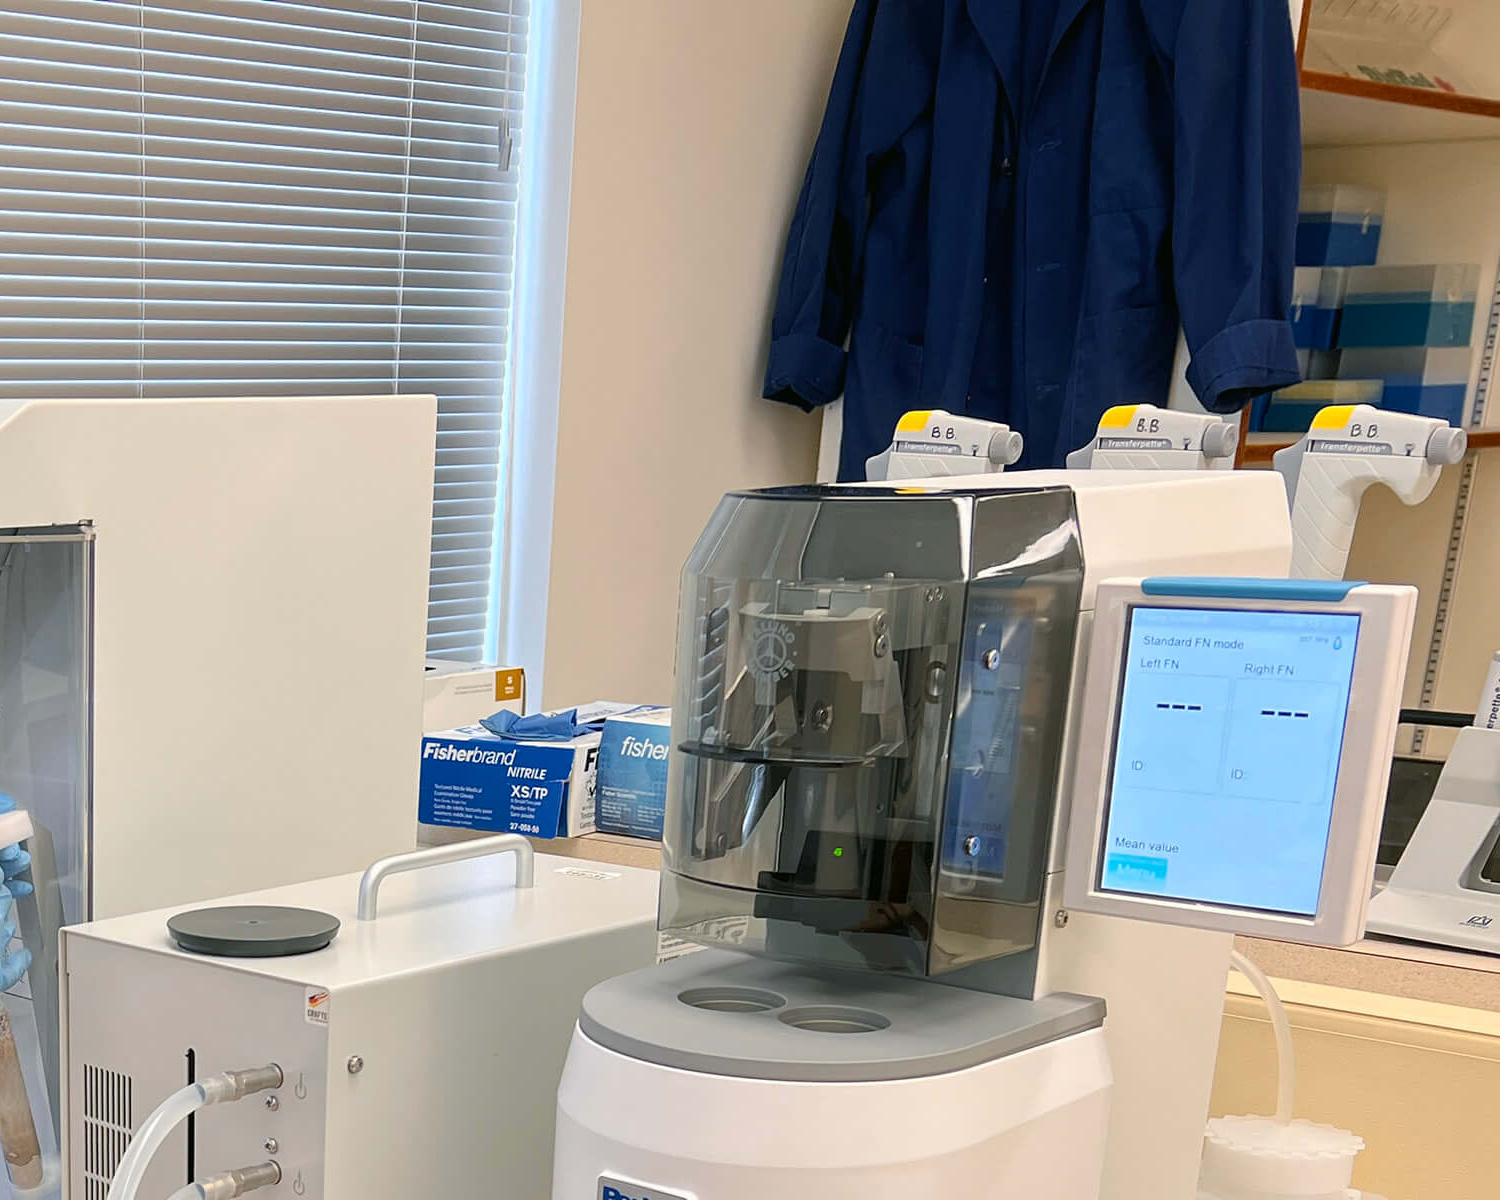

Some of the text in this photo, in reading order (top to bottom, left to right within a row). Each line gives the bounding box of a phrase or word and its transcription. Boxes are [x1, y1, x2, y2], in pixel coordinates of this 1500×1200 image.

[1143, 635, 1245, 650] Standard FN mode
[1141, 658, 1179, 670] Left FN
[1244, 663, 1294, 677] Right FN
[423, 743, 517, 766] Fisherbrand
[507, 766, 548, 780] NITRILE
[1115, 837, 1179, 853] Mean value
